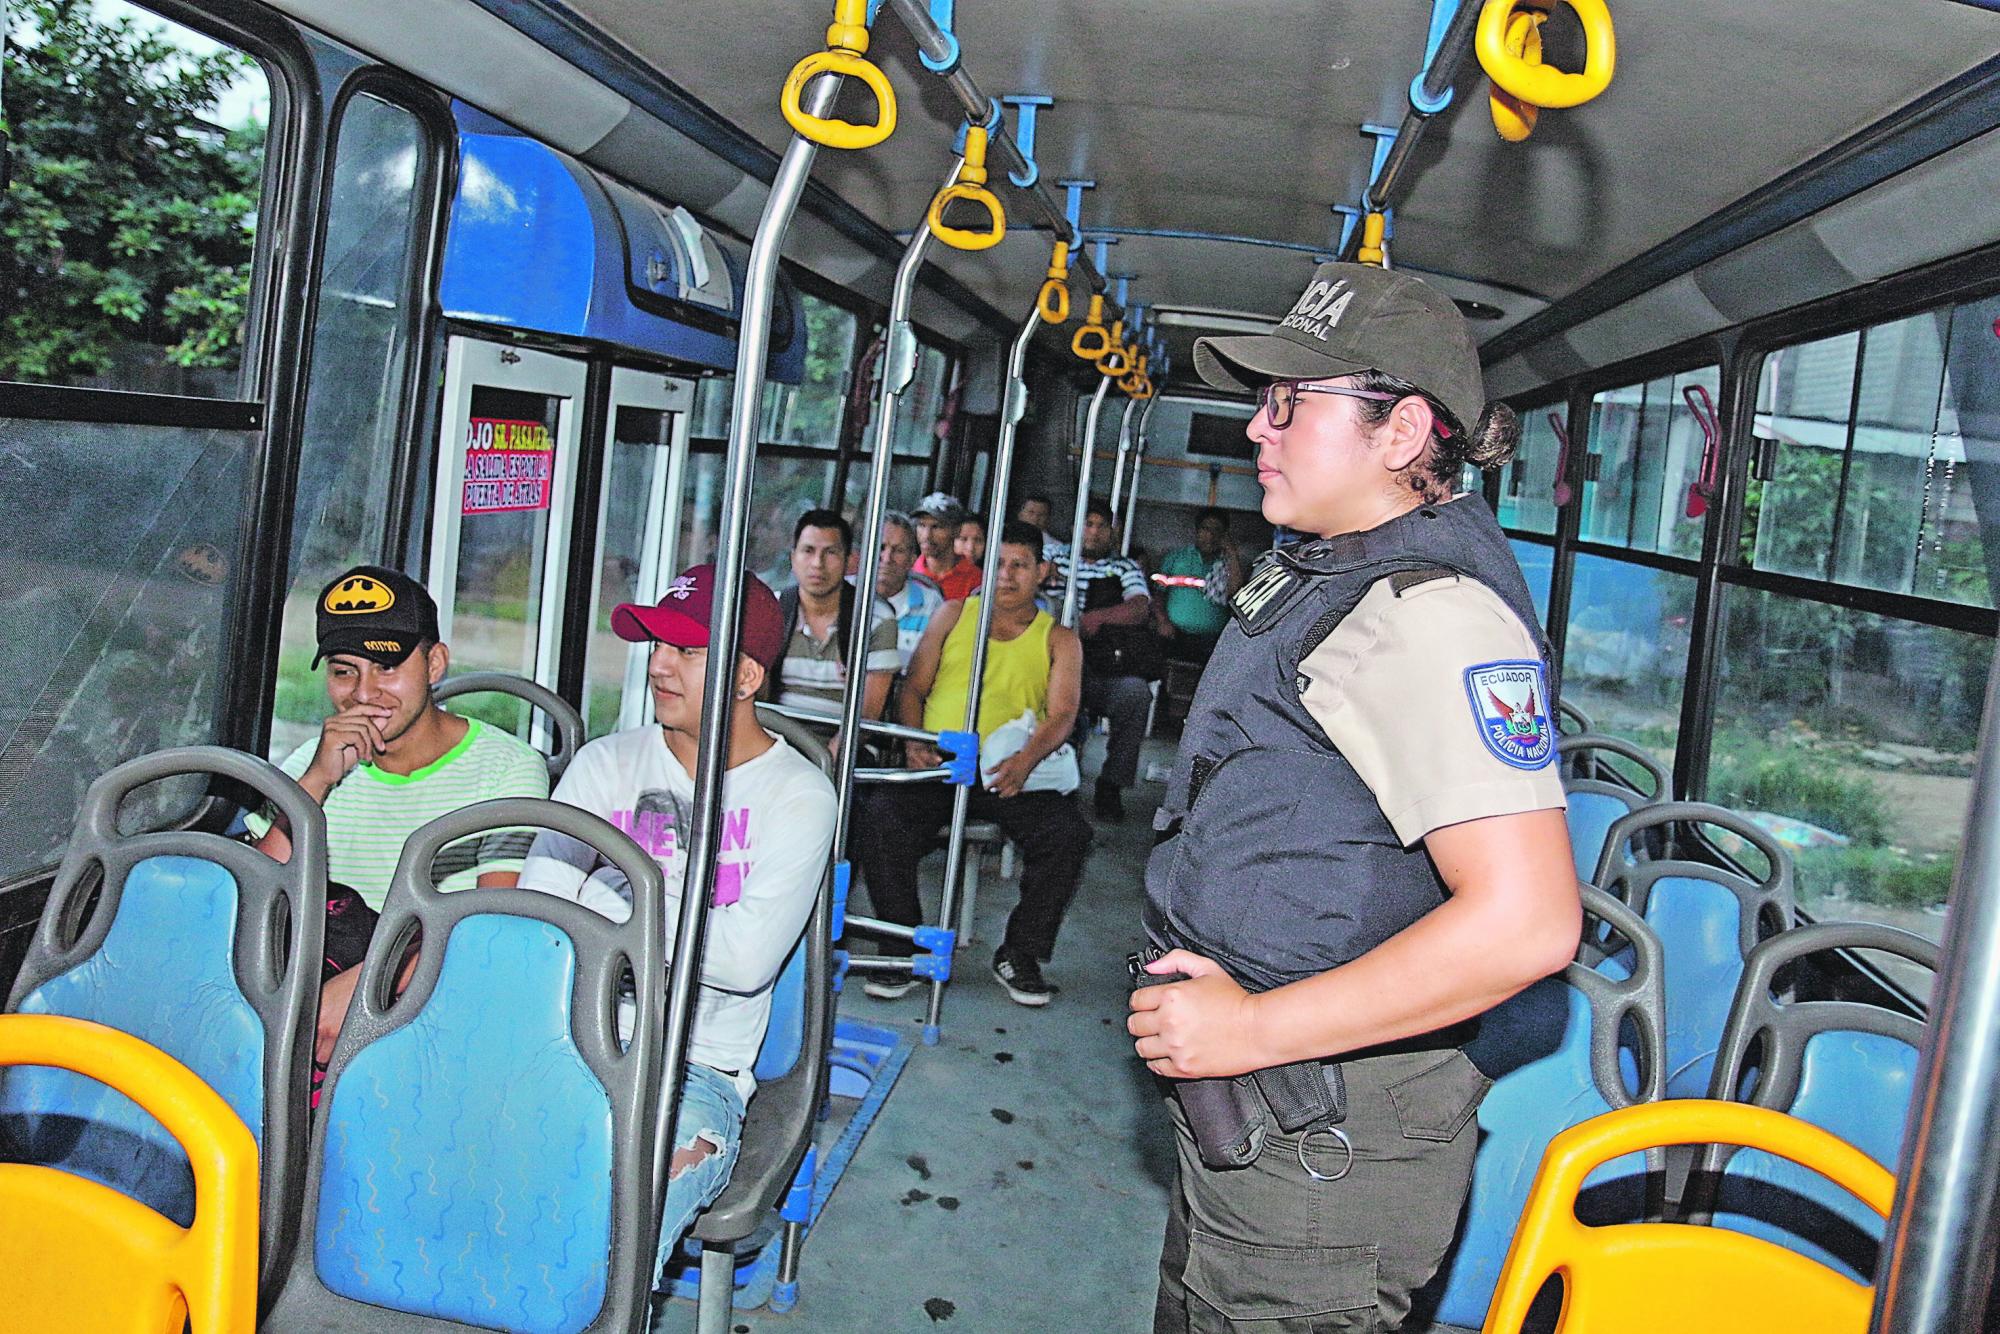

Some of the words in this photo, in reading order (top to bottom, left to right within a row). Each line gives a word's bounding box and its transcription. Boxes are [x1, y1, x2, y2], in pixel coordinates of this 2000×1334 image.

[475, 453, 507, 480] SALIDA
[464, 482, 500, 510] PUERTA
[1480, 671, 1533, 686] ECUADOR
[1525, 722, 1550, 760] NACIONAL
